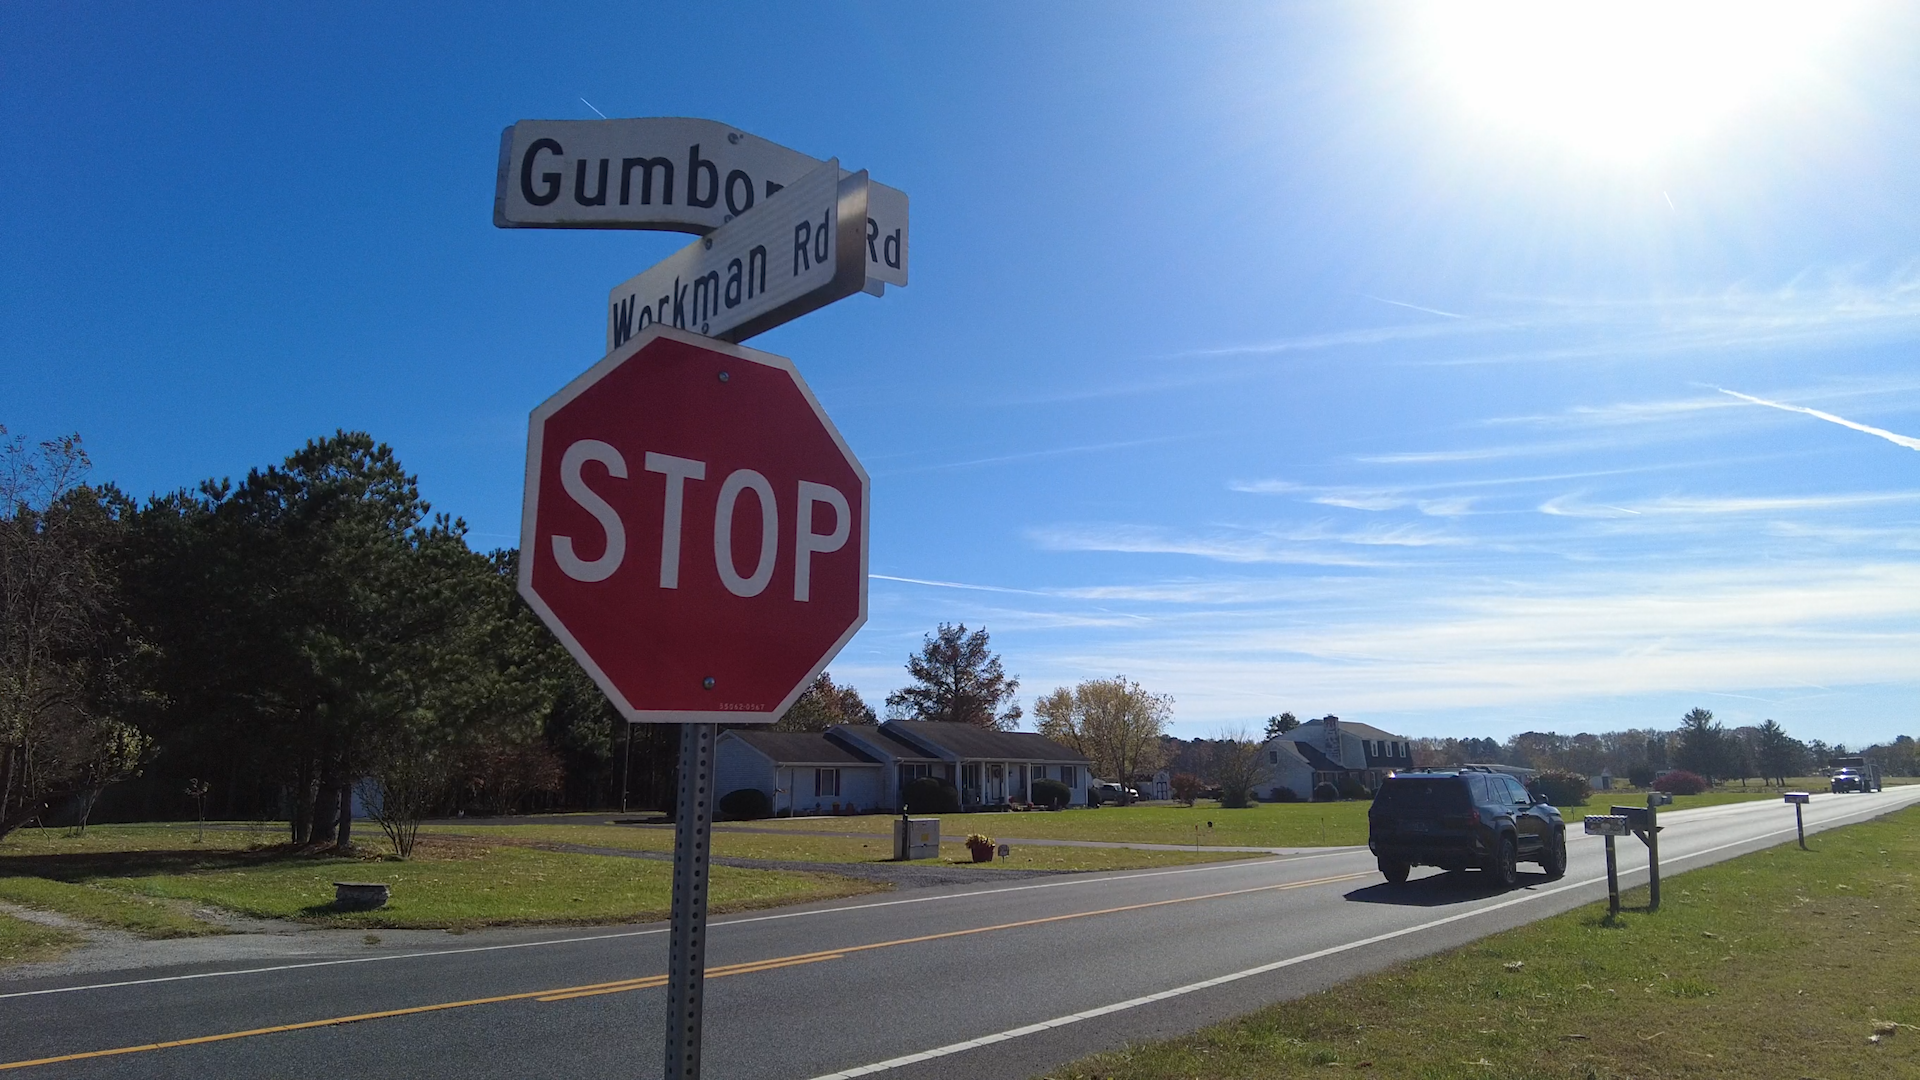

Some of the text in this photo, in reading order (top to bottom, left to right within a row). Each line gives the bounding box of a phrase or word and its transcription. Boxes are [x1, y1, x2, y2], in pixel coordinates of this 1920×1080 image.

[520, 137, 902, 270] Gumbo Rd
[612, 208, 830, 350] Workman Rd
[550, 438, 852, 603] STOP
